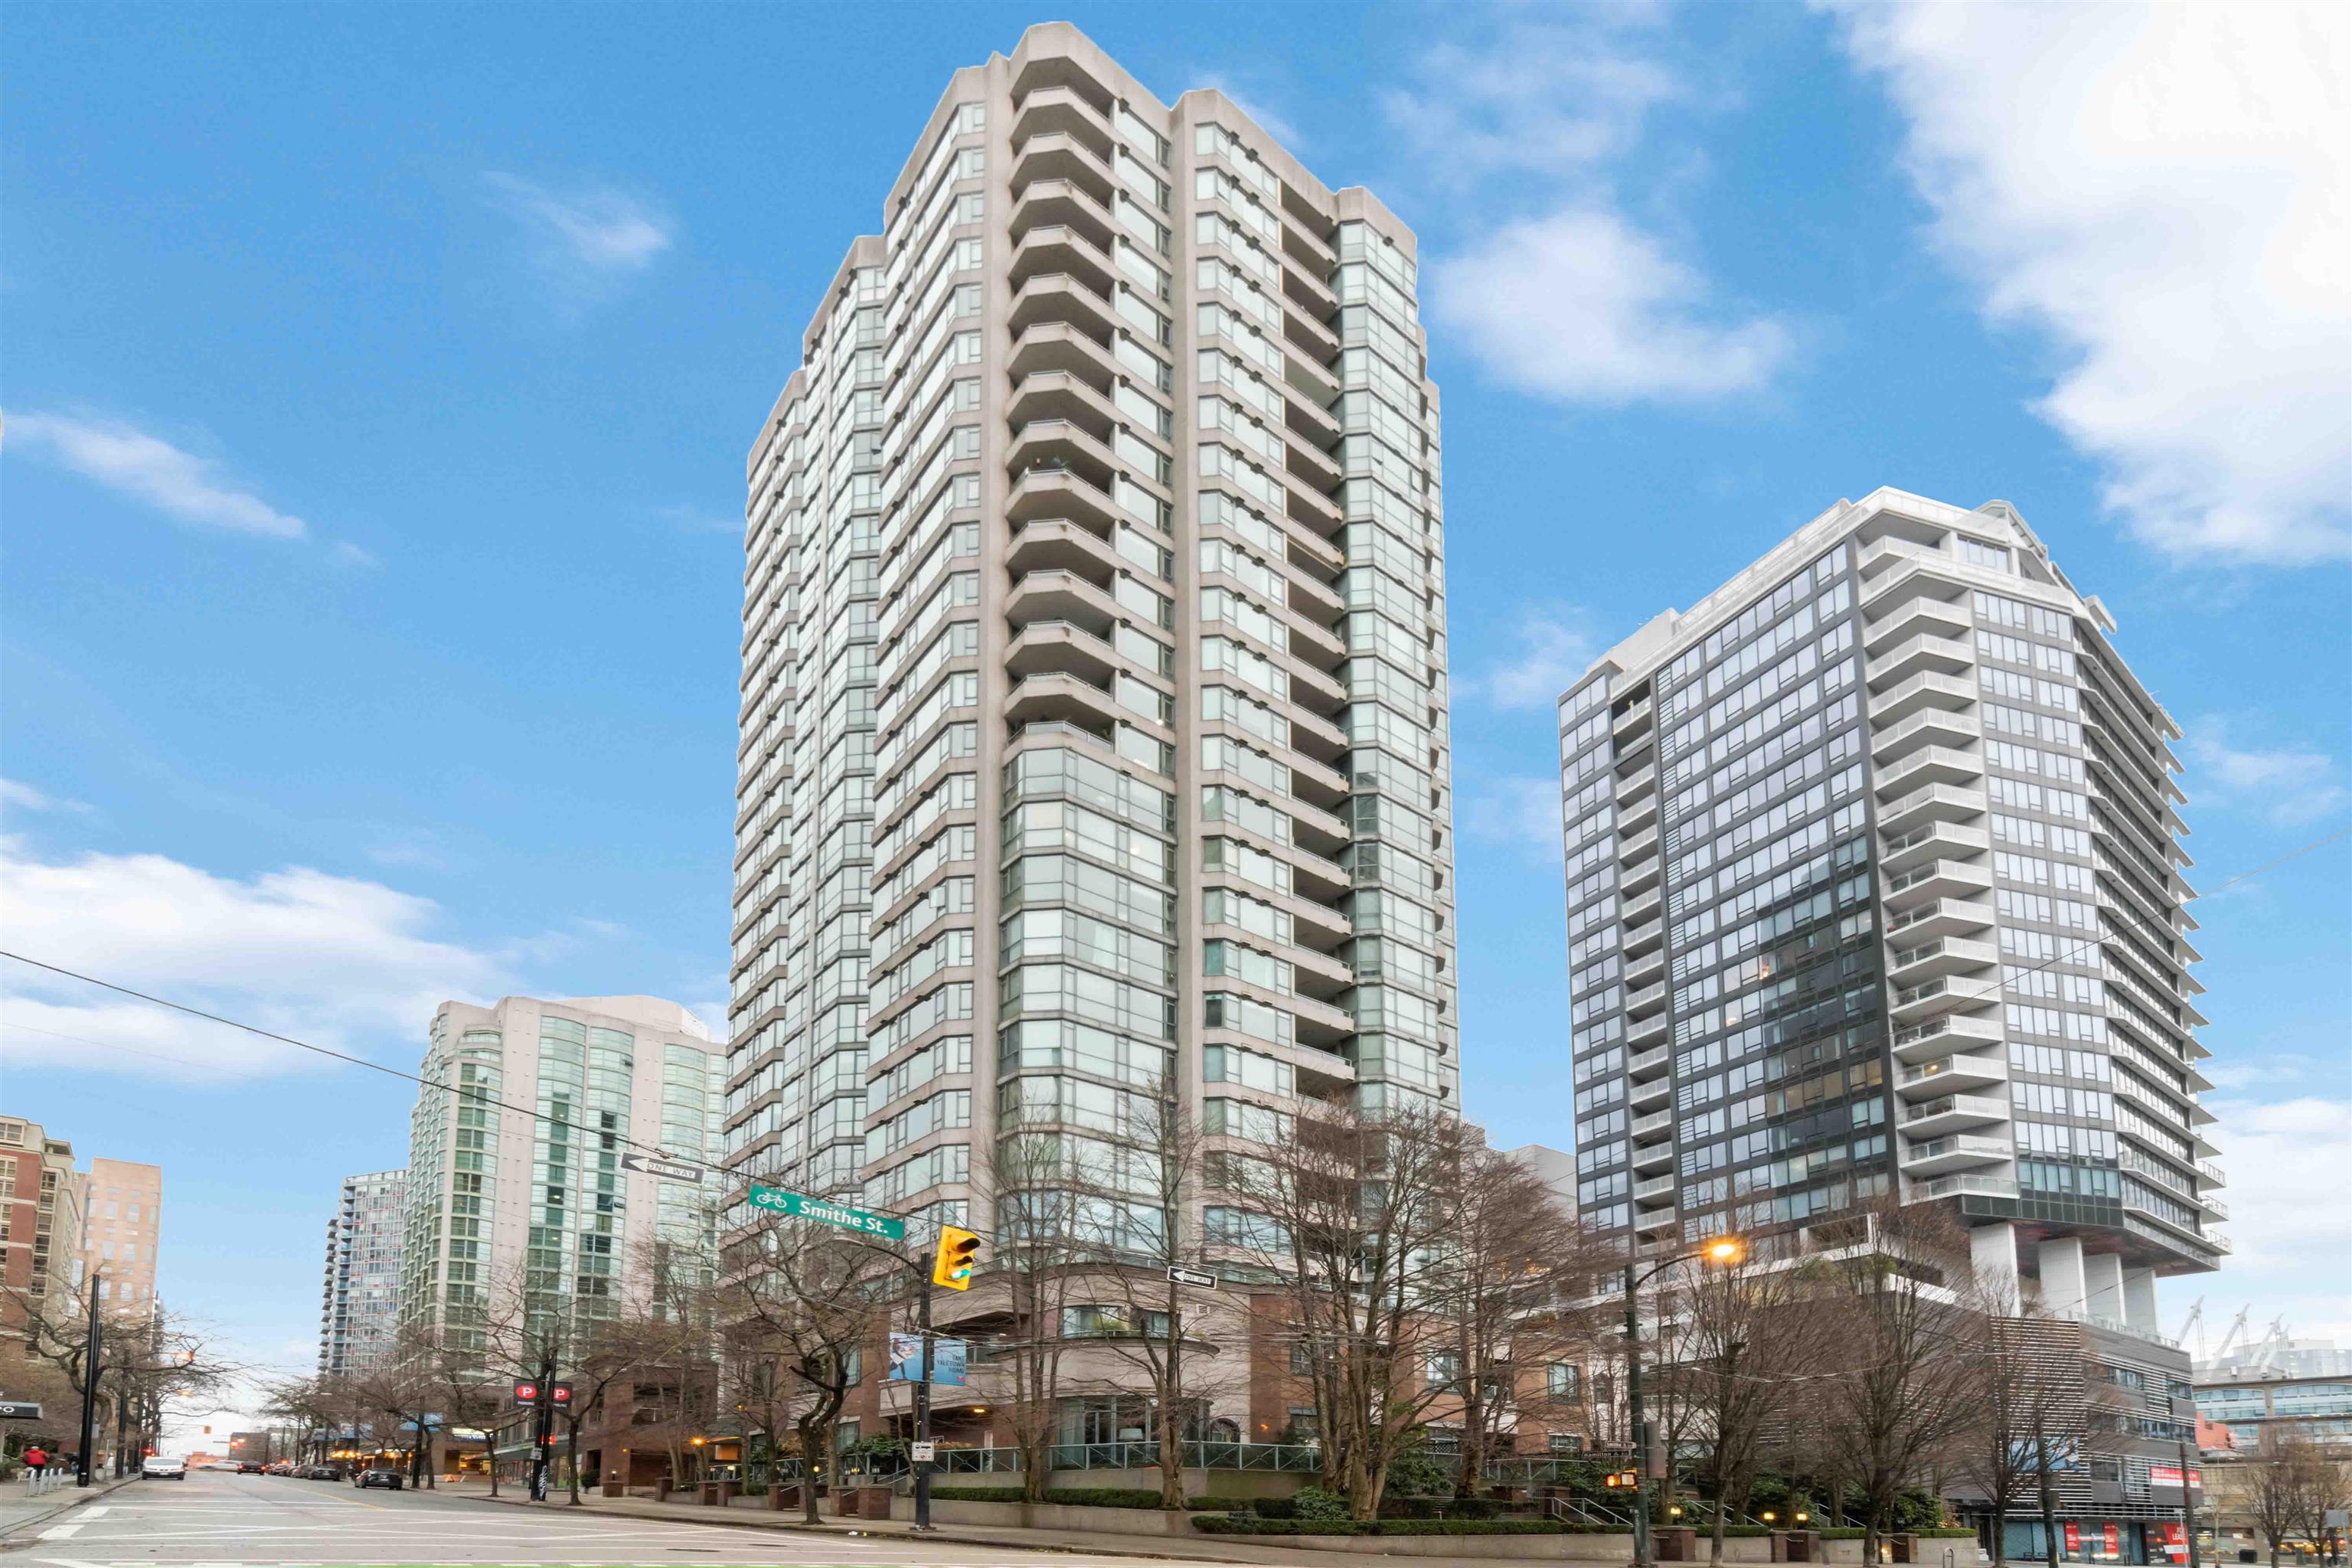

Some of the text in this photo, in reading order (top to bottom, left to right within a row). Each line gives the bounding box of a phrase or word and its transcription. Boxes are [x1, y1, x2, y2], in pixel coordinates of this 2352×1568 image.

[647, 1163, 695, 1178] ONE WAY
[799, 1200, 888, 1233] Smithe St.
[523, 1387, 533, 1396] P
[556, 1390, 565, 1399] P
